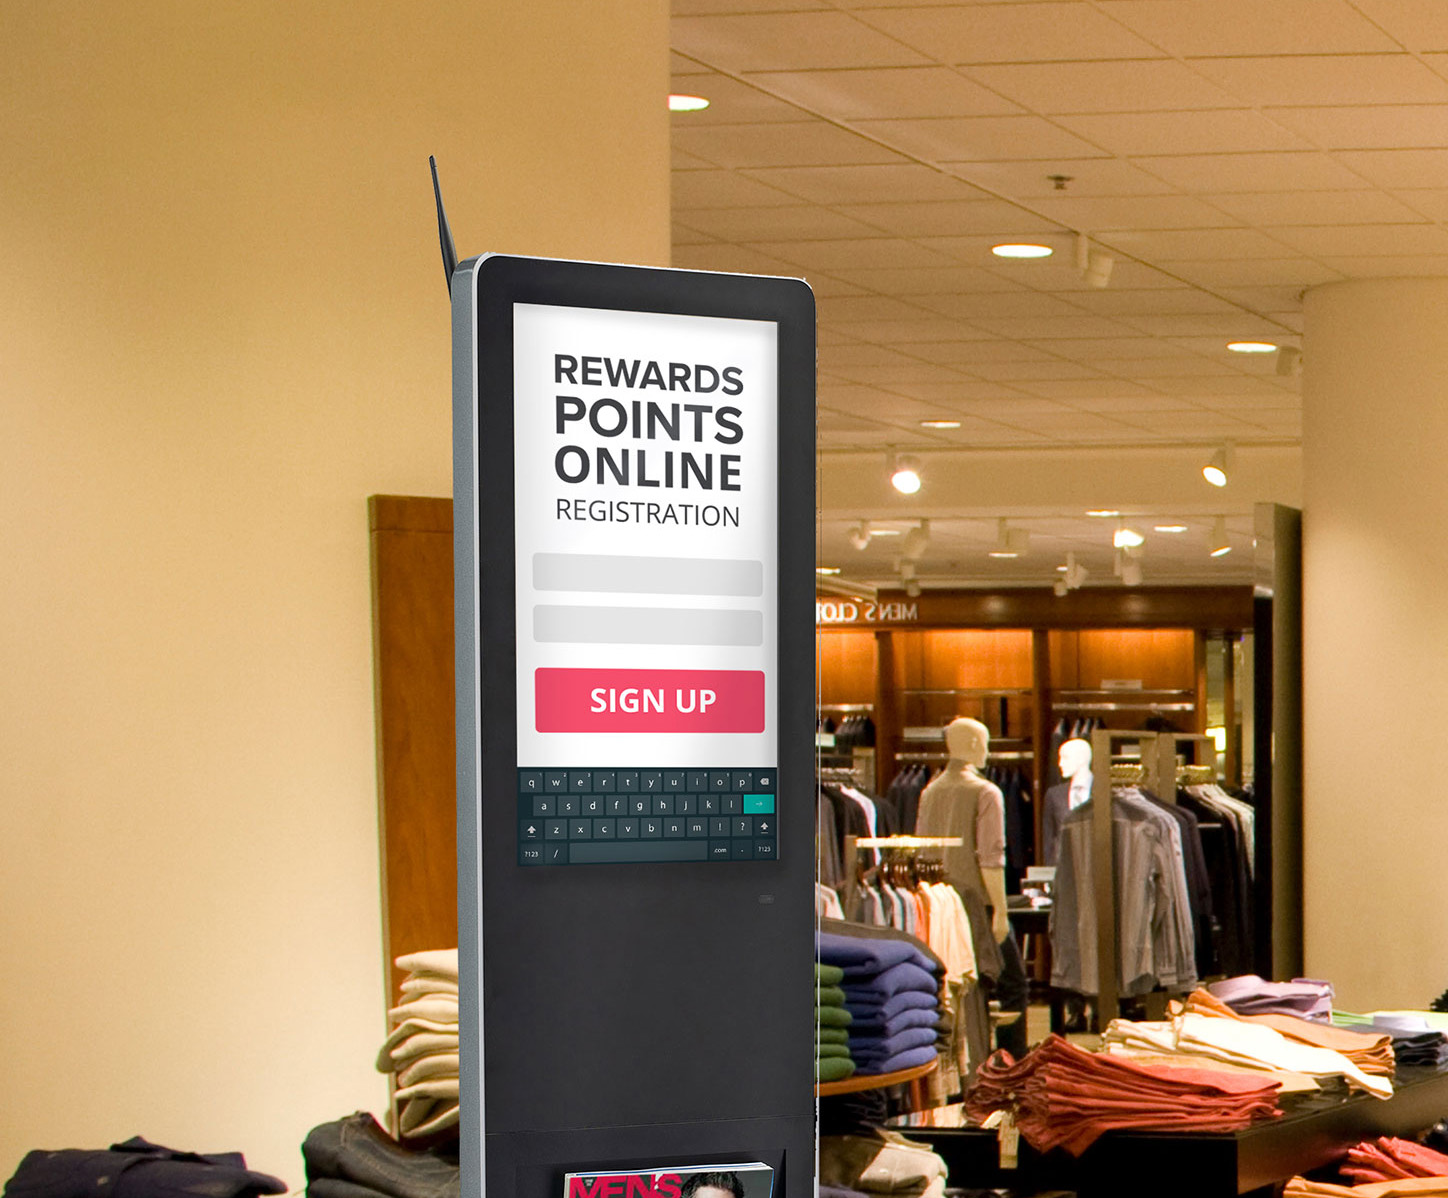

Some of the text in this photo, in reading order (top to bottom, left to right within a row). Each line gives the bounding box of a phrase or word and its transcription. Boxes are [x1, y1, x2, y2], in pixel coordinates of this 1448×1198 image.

[554, 353, 744, 396] REWARDS
[555, 395, 744, 445] POINTS
[554, 444, 742, 492] ONLINE
[556, 498, 740, 528] REGISTRATION
[590, 688, 717, 714] SIGN UP
